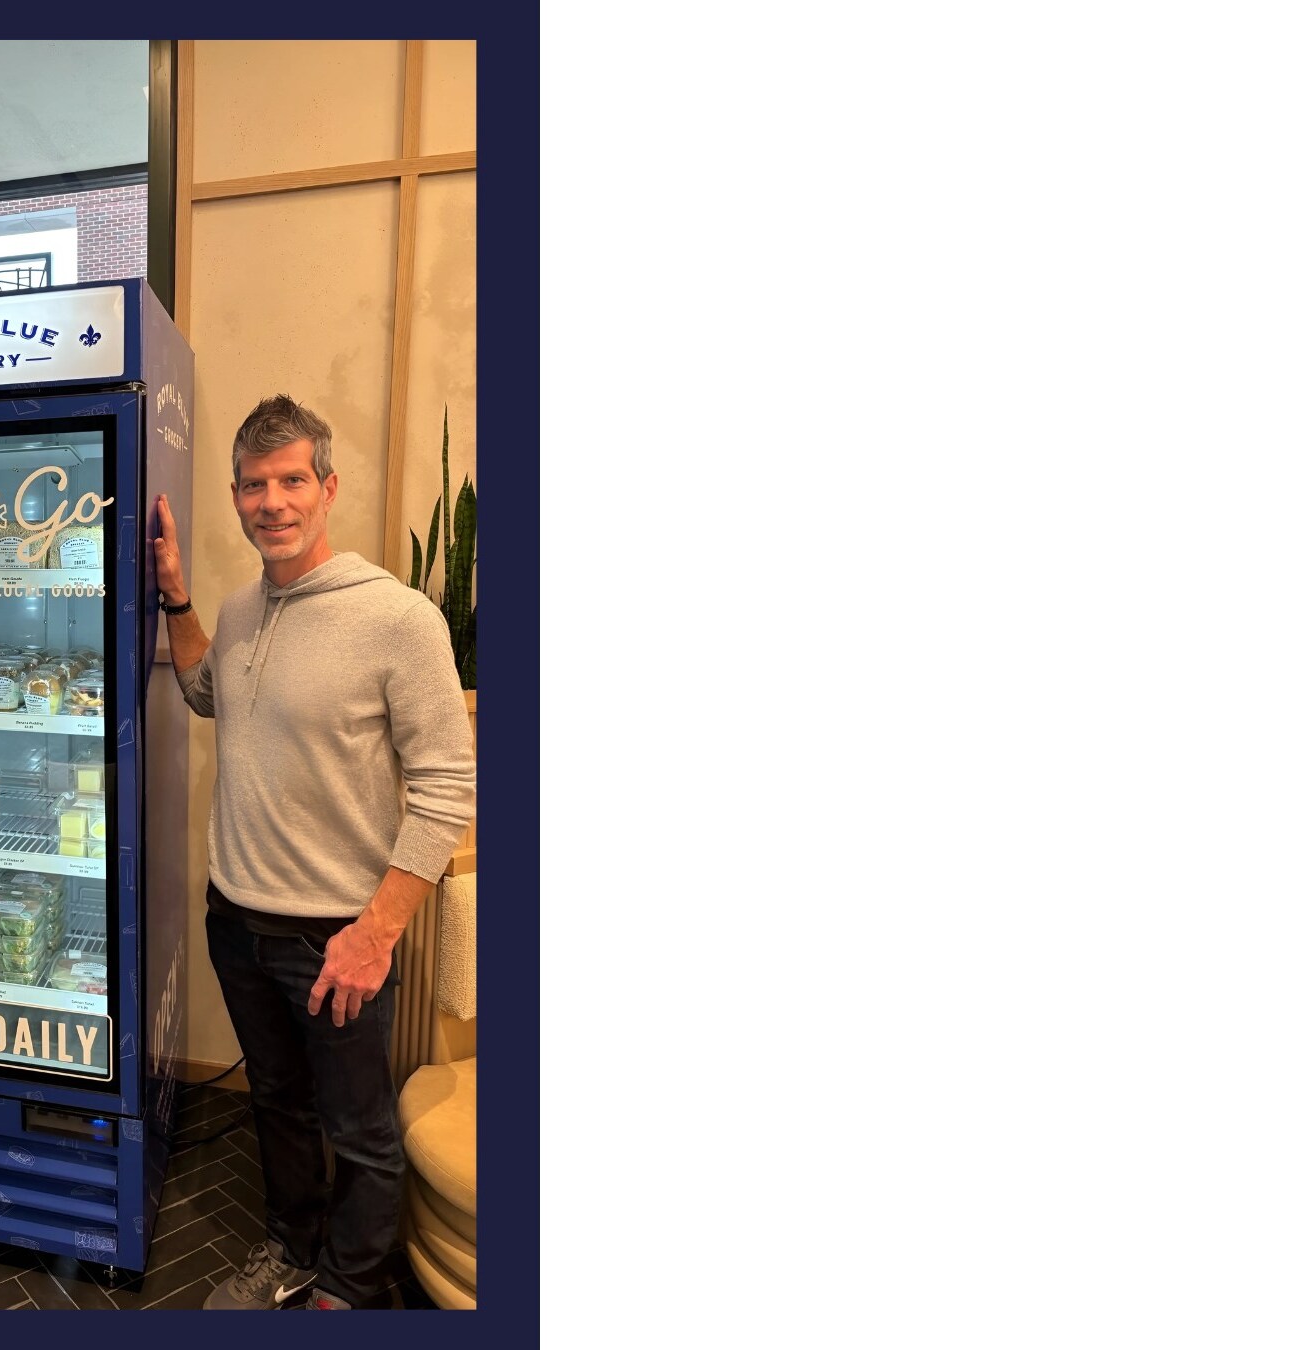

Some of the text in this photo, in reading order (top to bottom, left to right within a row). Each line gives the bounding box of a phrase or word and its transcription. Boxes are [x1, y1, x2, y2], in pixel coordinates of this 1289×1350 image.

[157, 383, 176, 416] ROYAL
[14, 465, 115, 562] Go
[51, 584, 106, 597] GOODS
[154, 950, 177, 1075] OPEN
